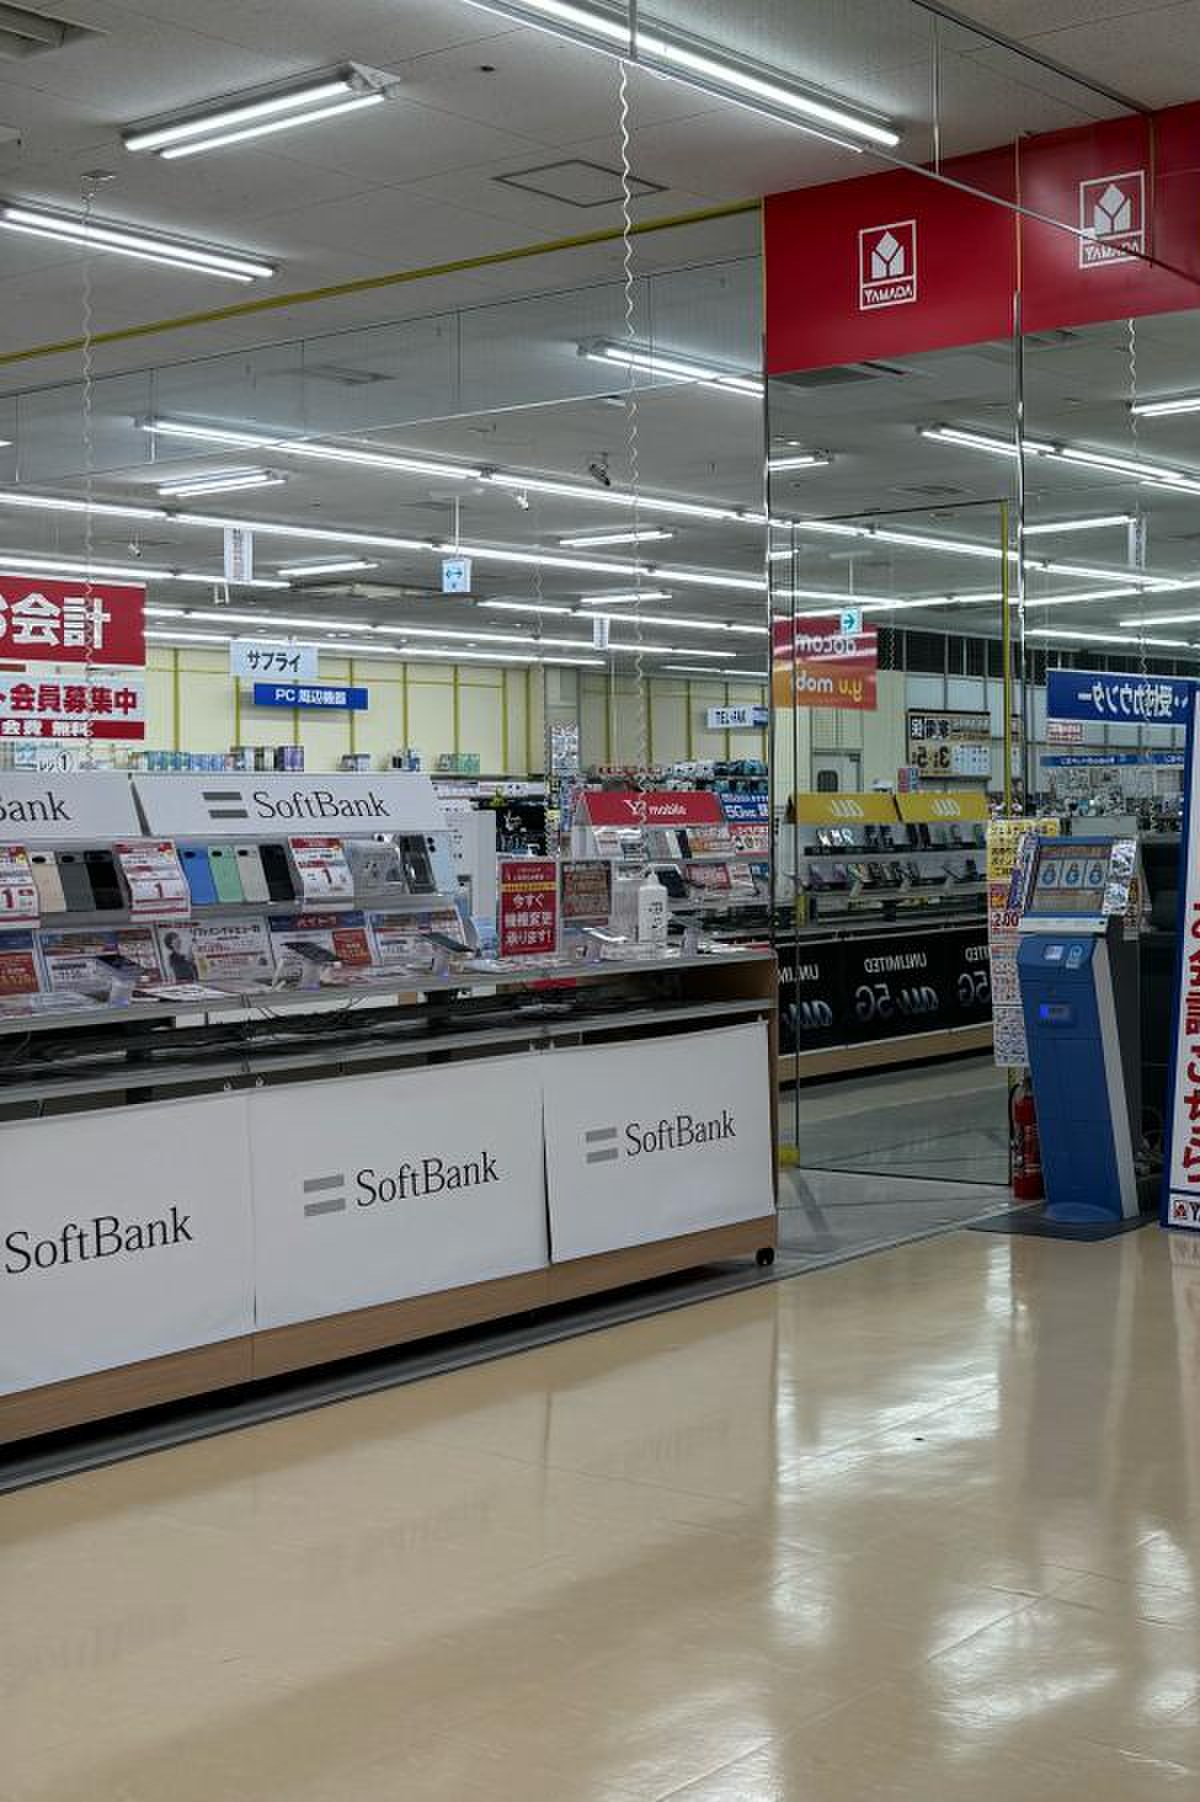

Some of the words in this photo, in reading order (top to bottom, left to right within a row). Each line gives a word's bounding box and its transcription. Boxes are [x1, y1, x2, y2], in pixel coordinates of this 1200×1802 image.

[1084, 240, 1140, 261] YAMADA
[864, 285, 913, 303] YAMADA
[0, 592, 111, 649] 会計
[248, 651, 300, 672] サプライ
[0, 684, 137, 715] 会員募集中
[275, 691, 295, 702] PC
[253, 792, 391, 819] SoftBank
[624, 1110, 737, 1157] SoftBank
[355, 1151, 500, 1207] SoftBank
[4, 1207, 193, 1275] SoftBank
